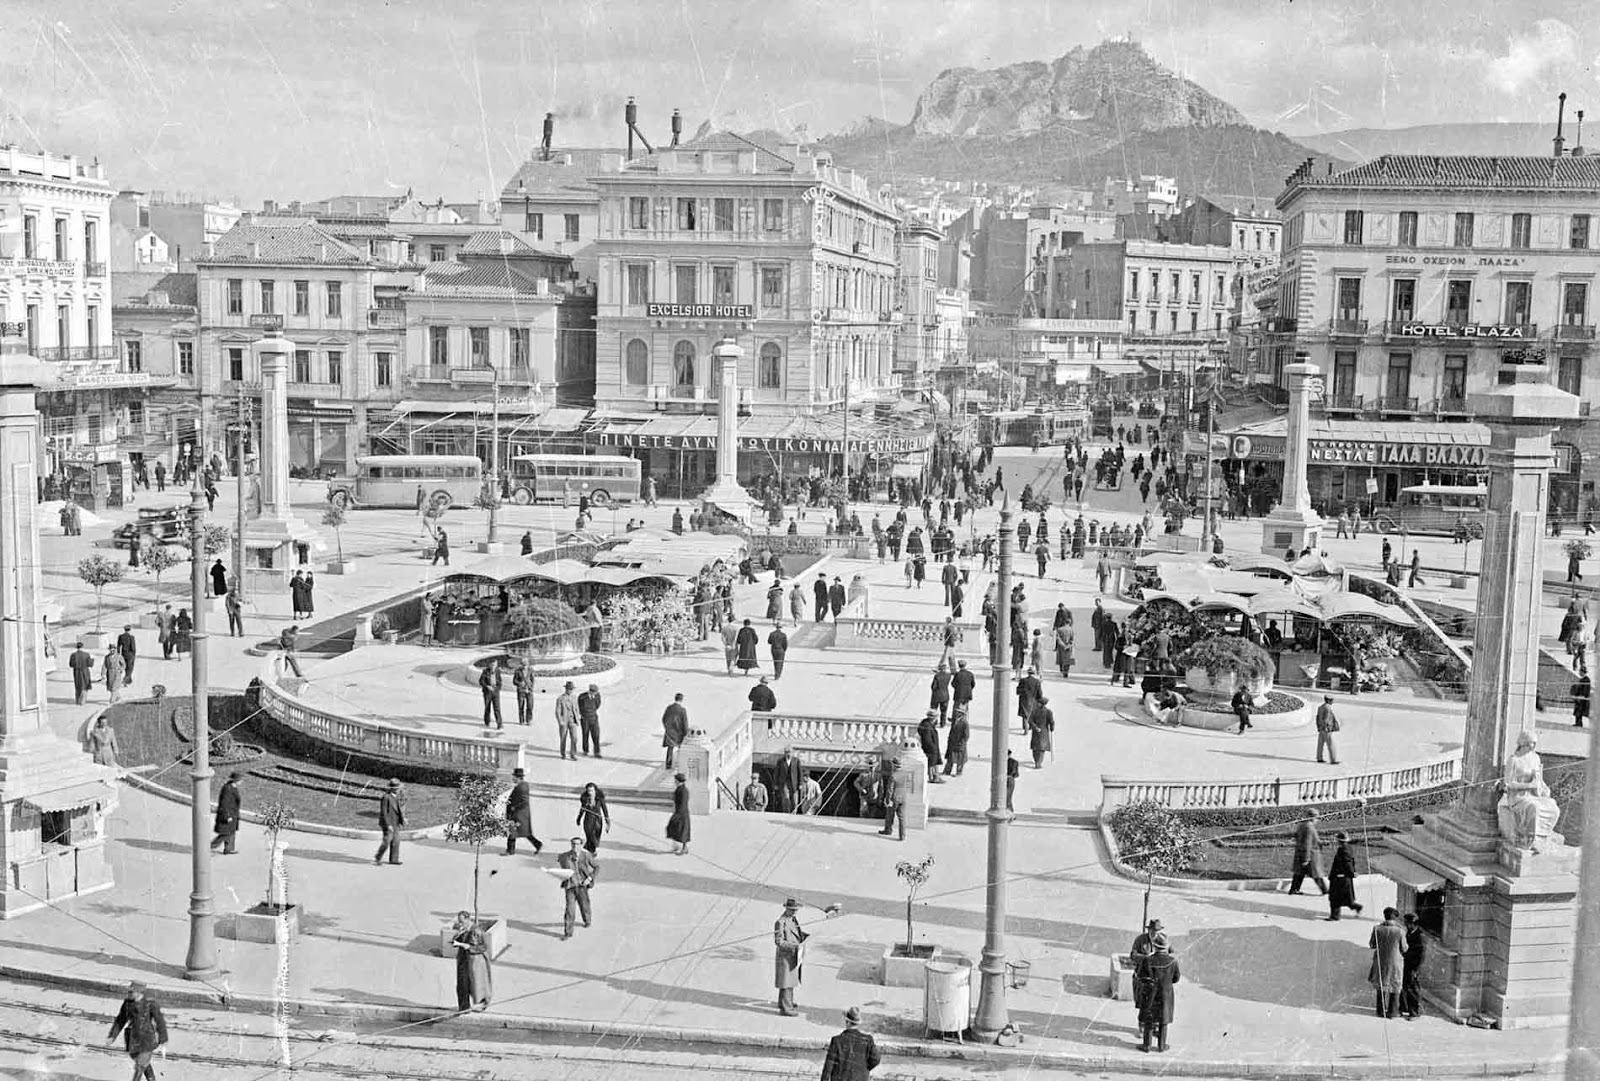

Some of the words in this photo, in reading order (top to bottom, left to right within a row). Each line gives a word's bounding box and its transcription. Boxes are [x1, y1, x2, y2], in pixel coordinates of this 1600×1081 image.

[801, 186, 836, 204] HOTEL
[649, 304, 711, 316] EXCELSIOR
[716, 305, 752, 317] HOTEL
[1402, 325, 1457, 337] HOTEL
[600, 433, 673, 447] ΠΙΝΕΤΕ
[1311, 449, 1374, 462] ΝΕΣΤΛΕ
